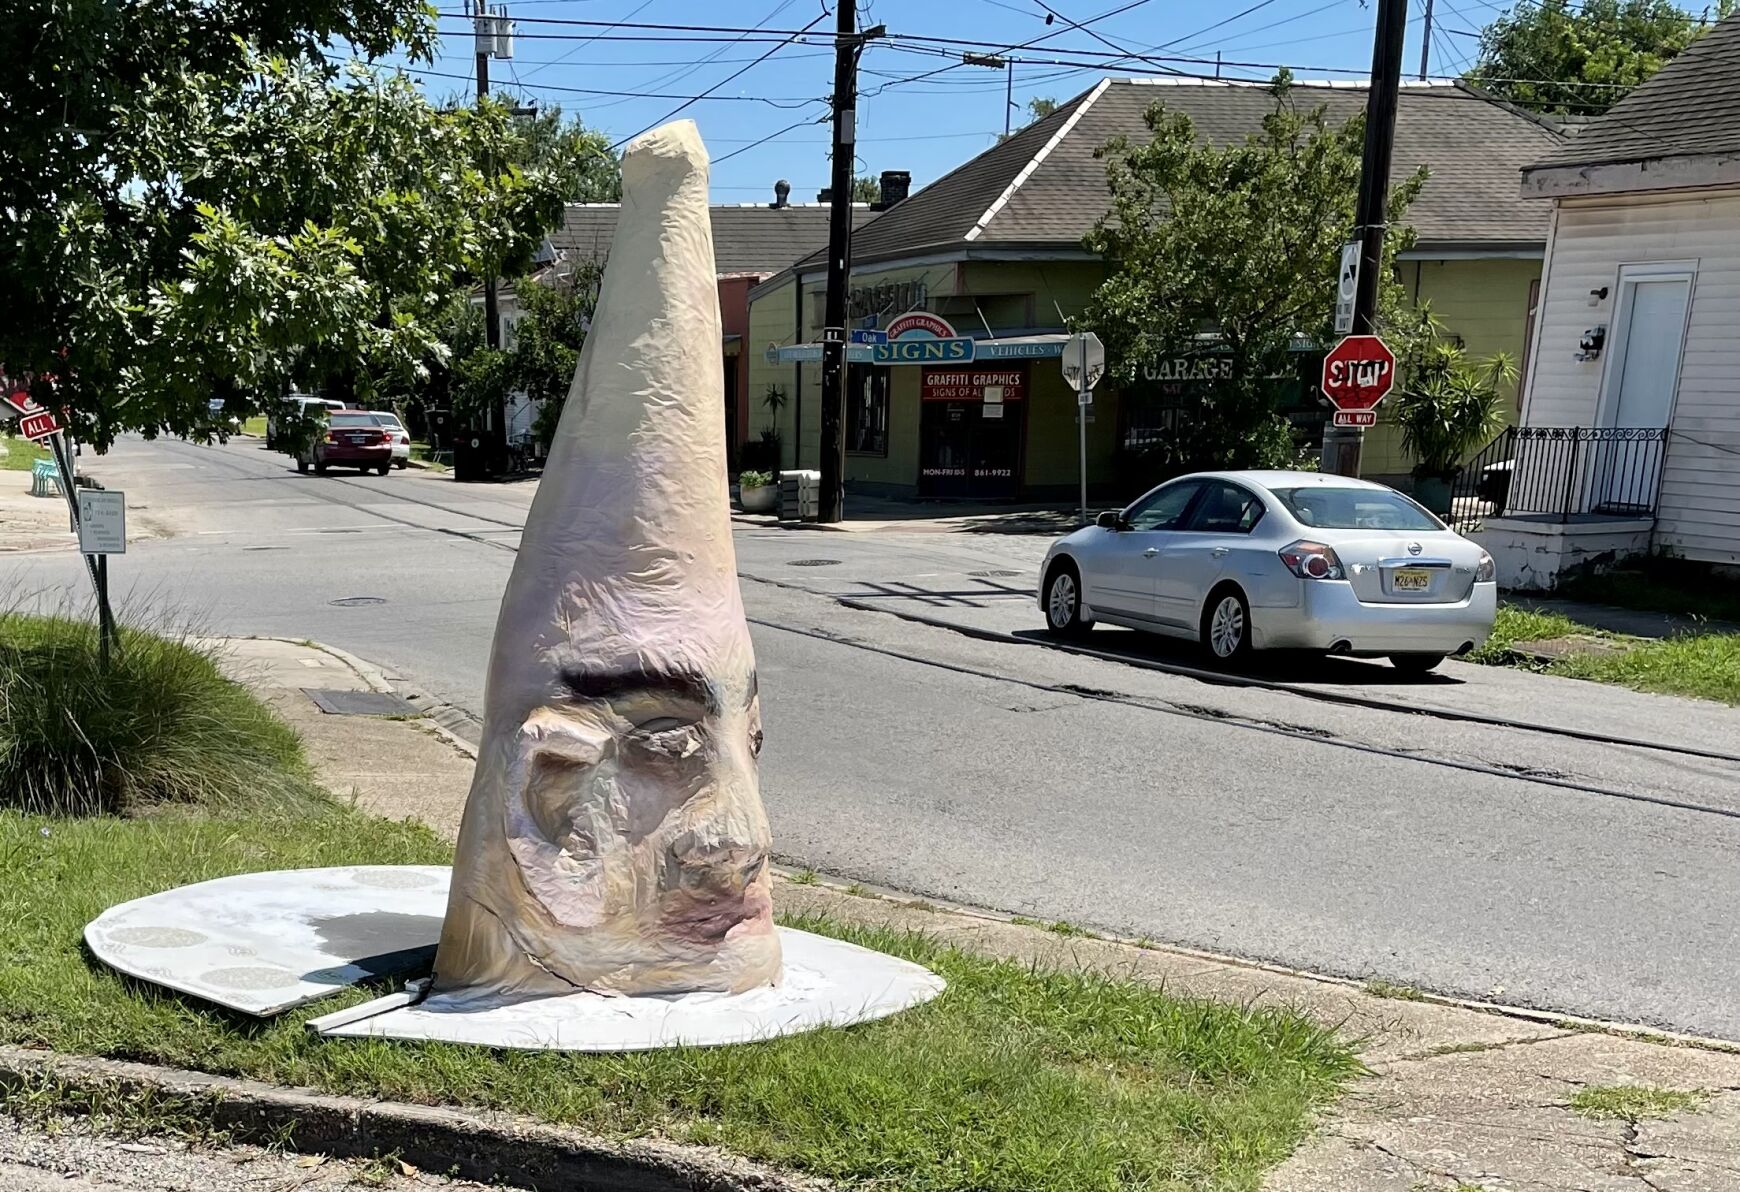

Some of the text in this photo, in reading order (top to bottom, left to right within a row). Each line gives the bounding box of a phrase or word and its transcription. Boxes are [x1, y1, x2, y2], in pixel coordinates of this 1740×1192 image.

[889, 319, 915, 338] GRAFFITI
[916, 318, 948, 337] GRAPHICS
[861, 332, 877, 343] Oak
[878, 341, 965, 359] SIGNS
[990, 345, 1044, 356] VEHICLES
[1143, 358, 1234, 381] GARAGE
[1328, 359, 1390, 388] STOP
[927, 374, 1020, 386] GRAFFITI GRAPHICS
[932, 387, 956, 397] SIGNS
[958, 387, 970, 397] OF
[1337, 413, 1372, 424] ALL WAY
[27, 419, 48, 435] ALL
